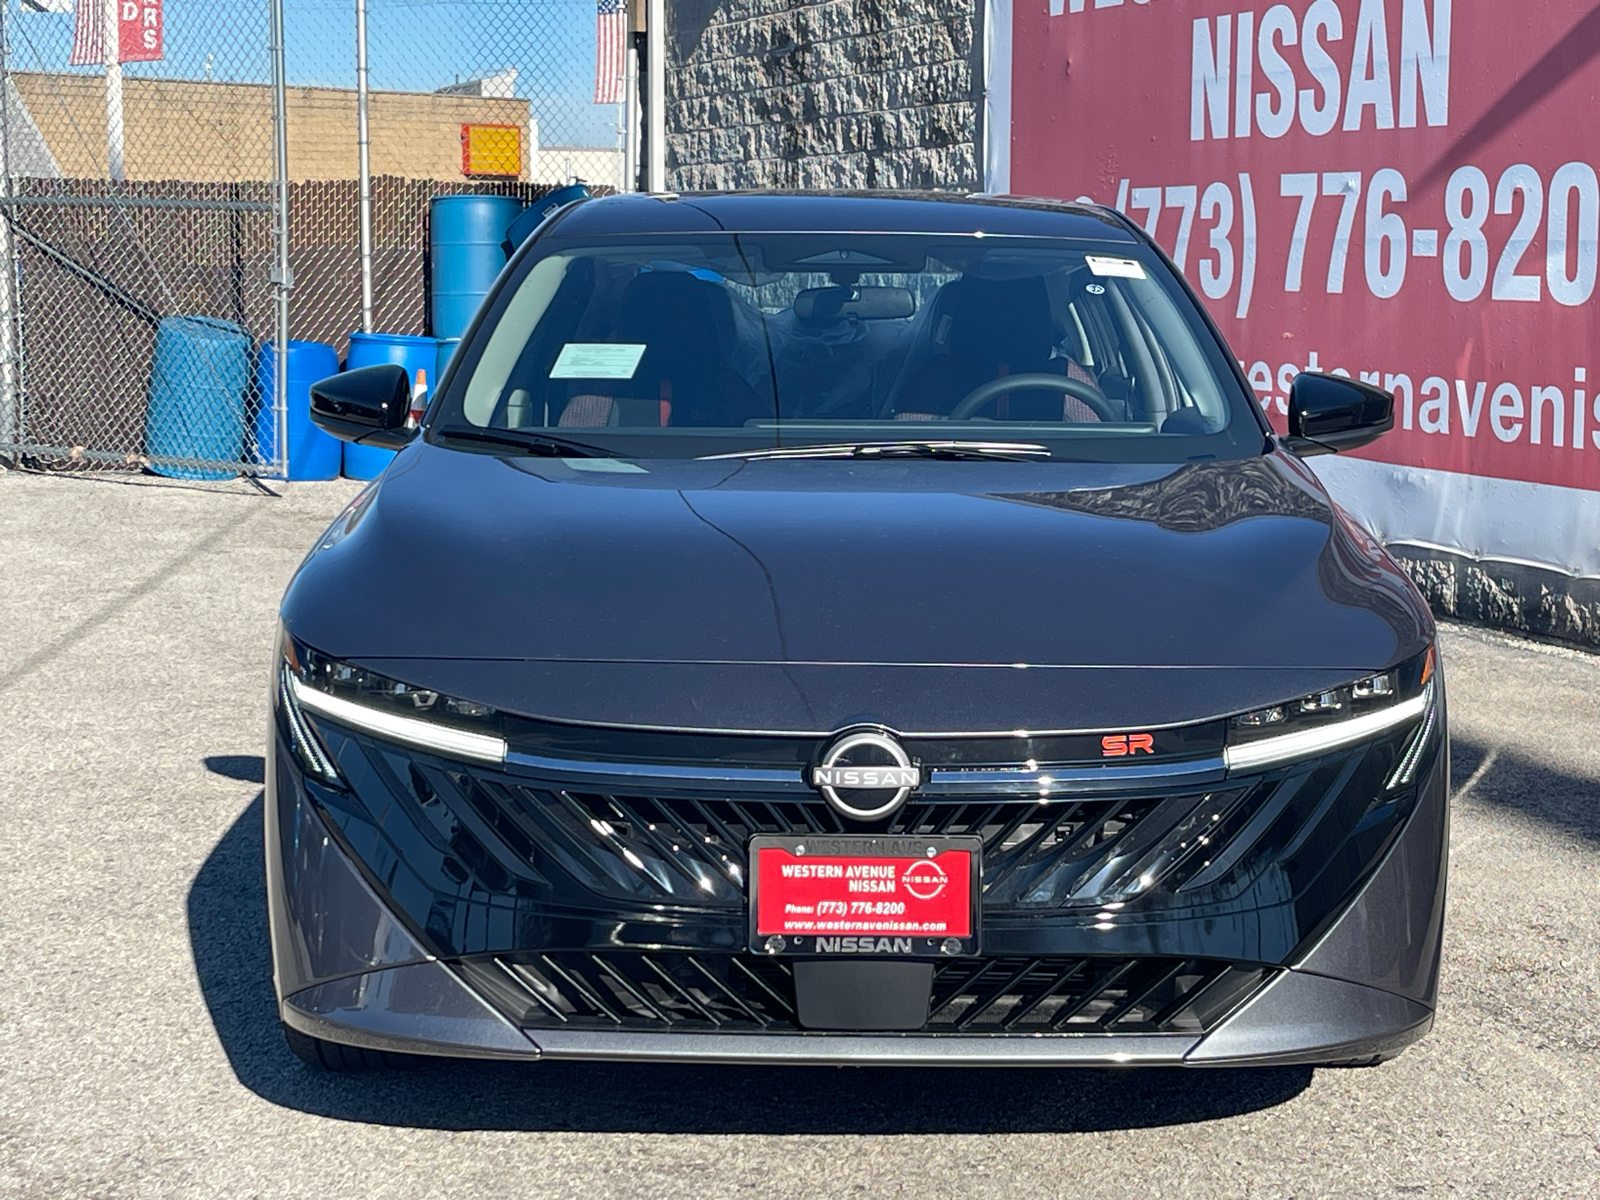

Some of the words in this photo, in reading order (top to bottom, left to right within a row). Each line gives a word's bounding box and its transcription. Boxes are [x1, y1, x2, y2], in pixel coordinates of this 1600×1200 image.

[1190, 0, 1452, 141] NISSAN
[1280, 161, 1600, 307] 776-820
[1101, 733, 1154, 757] SR
[814, 769, 919, 786] NISSAN
[781, 864, 843, 879] WESTERN
[846, 864, 896, 879] AVENUE
[902, 875, 949, 885] NISSAN
[849, 879, 896, 893] NISSAN
[785, 903, 815, 915] Phone:
[816, 900, 848, 917] (773)
[850, 901, 906, 916] 776-8200
[783, 919, 947, 932] www.westernavenissan.com
[815, 936, 912, 954] NISSAN
